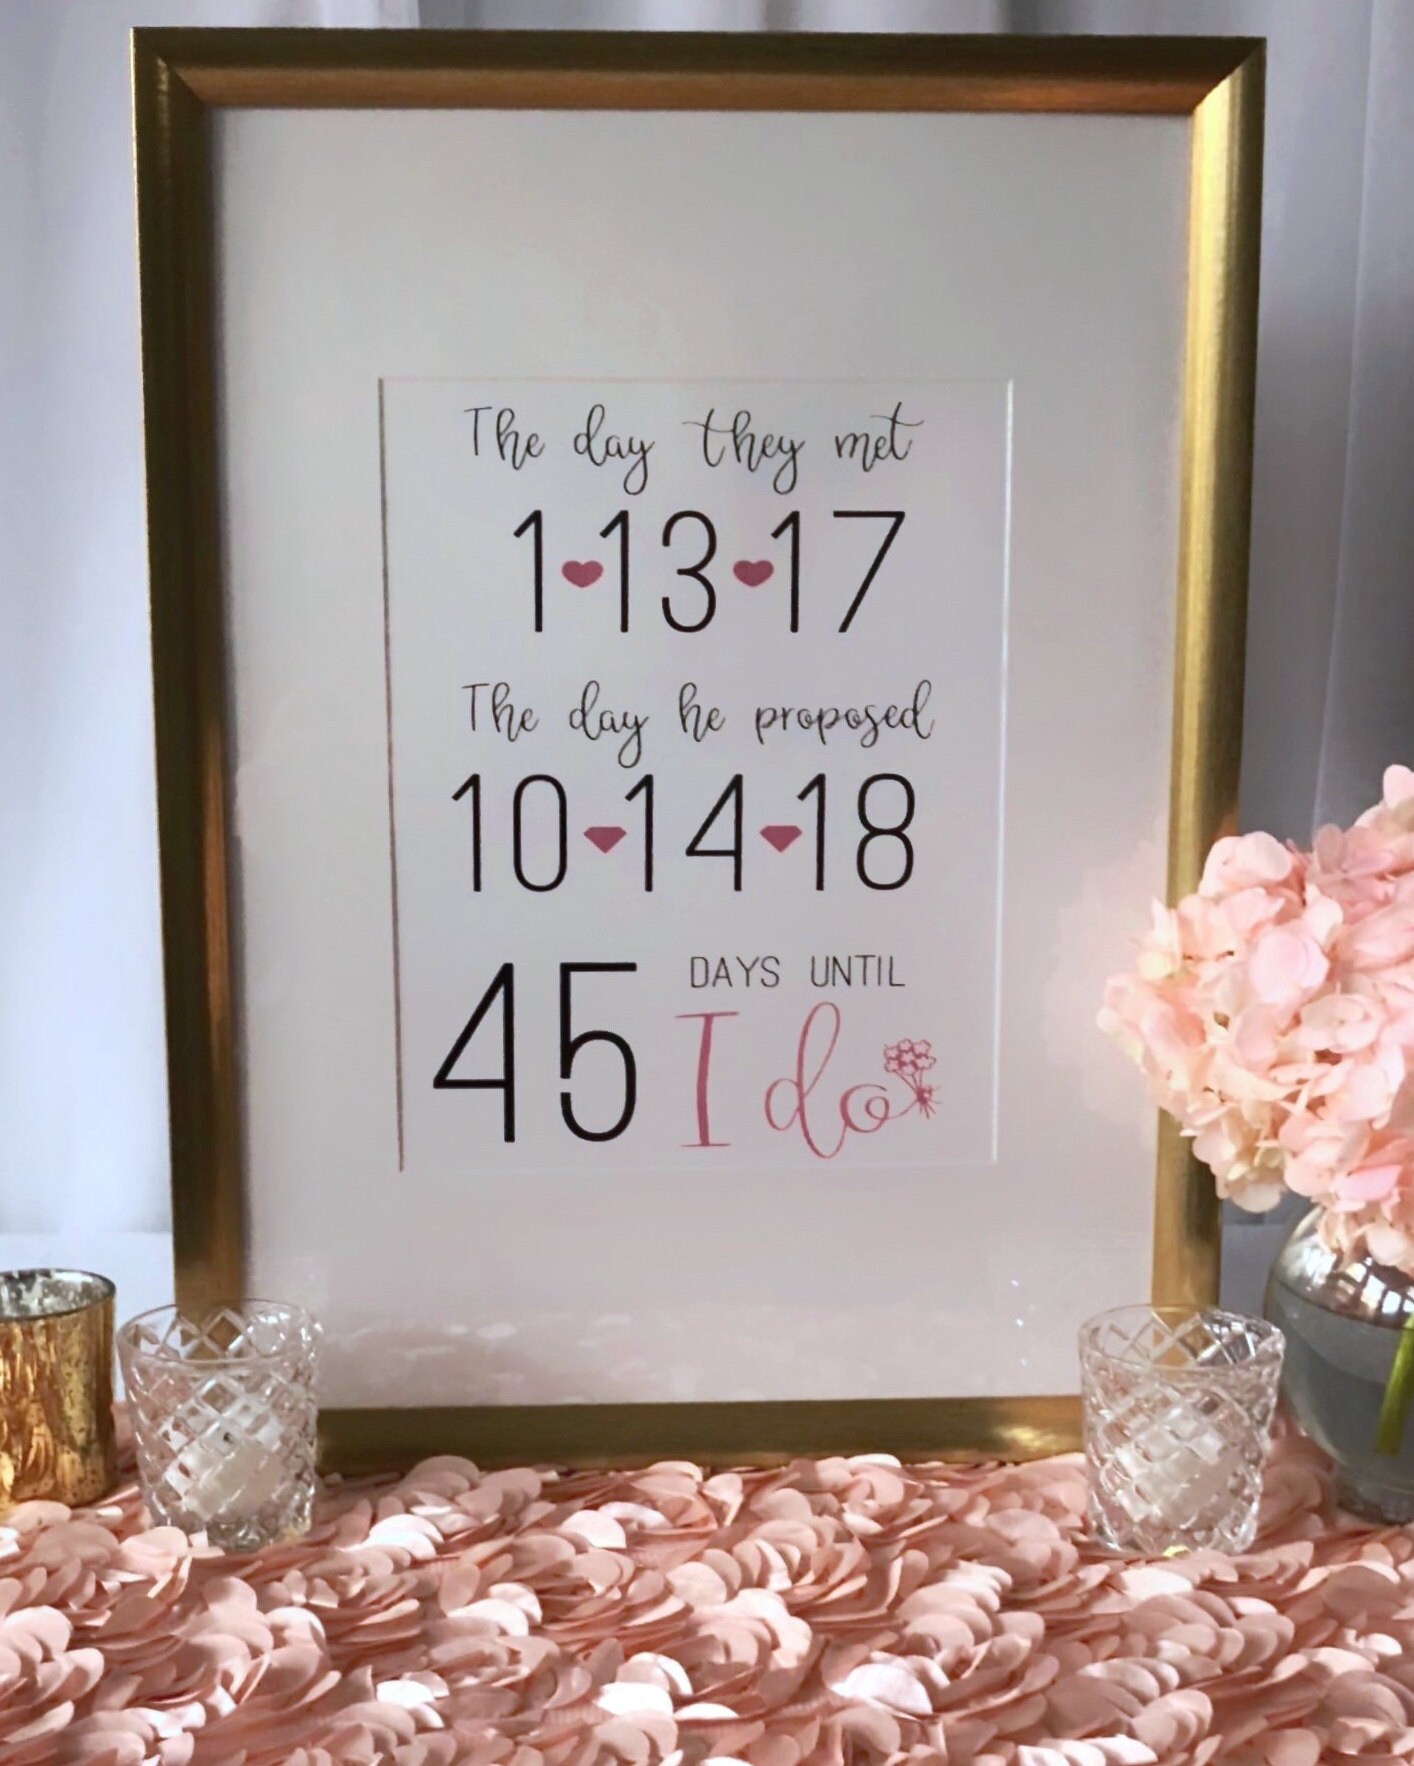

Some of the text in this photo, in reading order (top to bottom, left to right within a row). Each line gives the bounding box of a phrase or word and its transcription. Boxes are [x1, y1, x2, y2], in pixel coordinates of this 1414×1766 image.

[463, 401, 925, 496] The day they met
[461, 679, 935, 769] The day he proposed
[433, 955, 907, 1143] 45 DAYS UNTIL
[675, 1002, 893, 1159] I do
